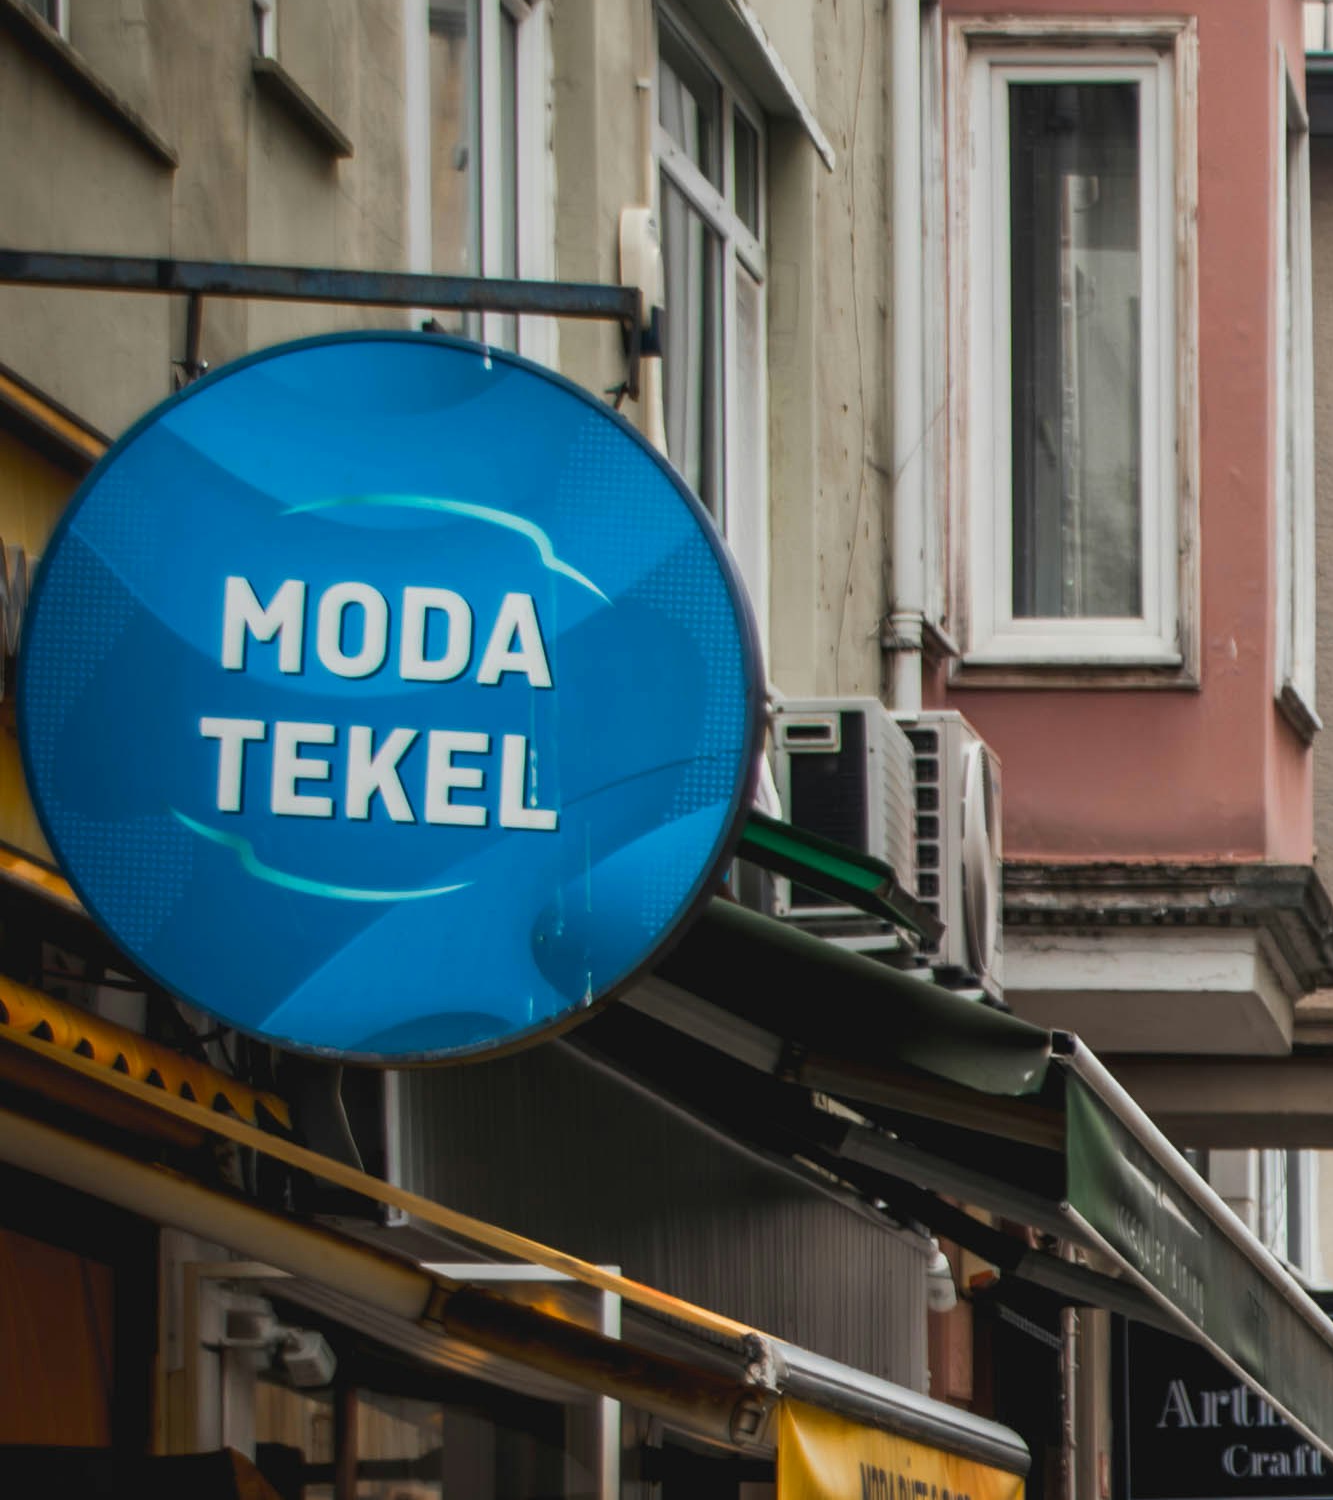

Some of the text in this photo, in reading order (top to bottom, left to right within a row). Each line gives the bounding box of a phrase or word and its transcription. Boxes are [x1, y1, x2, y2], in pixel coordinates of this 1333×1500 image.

[222, 576, 552, 688] MODA
[200, 717, 558, 831] TEKEL
[1222, 1444, 1326, 1478] Craft
